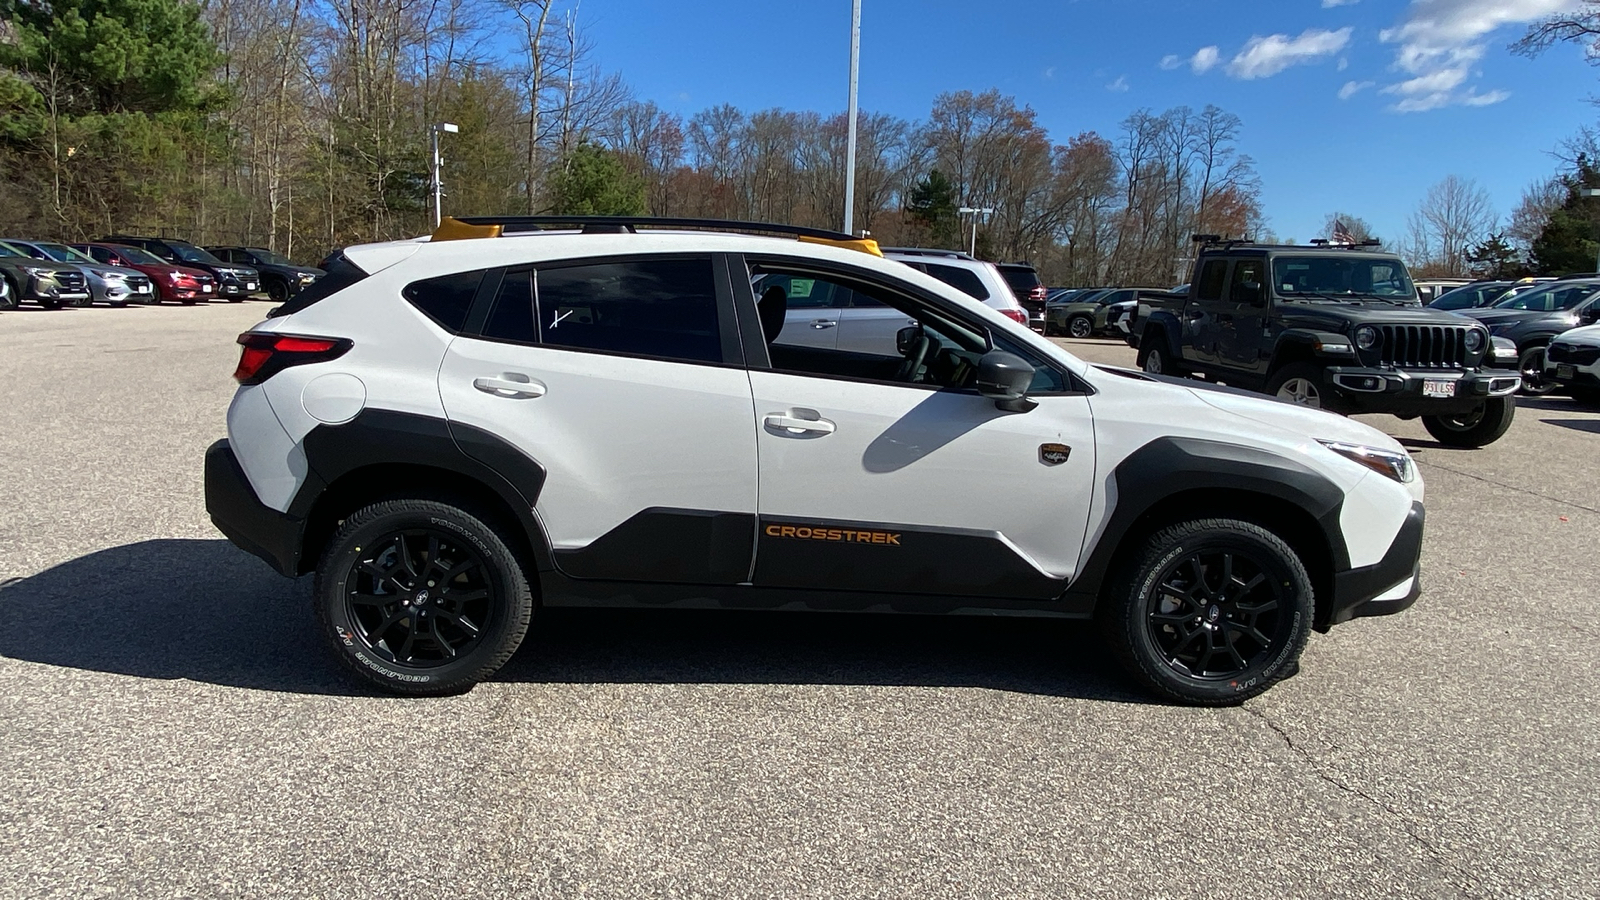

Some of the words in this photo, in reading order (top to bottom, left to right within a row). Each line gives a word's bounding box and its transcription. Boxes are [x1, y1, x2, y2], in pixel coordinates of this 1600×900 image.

[1424, 383, 1438, 392] 931
[431, 517, 492, 557] YOKOHAMA
[765, 525, 902, 546] CROSSTREK
[356, 652, 429, 682] GEOLANDAR
